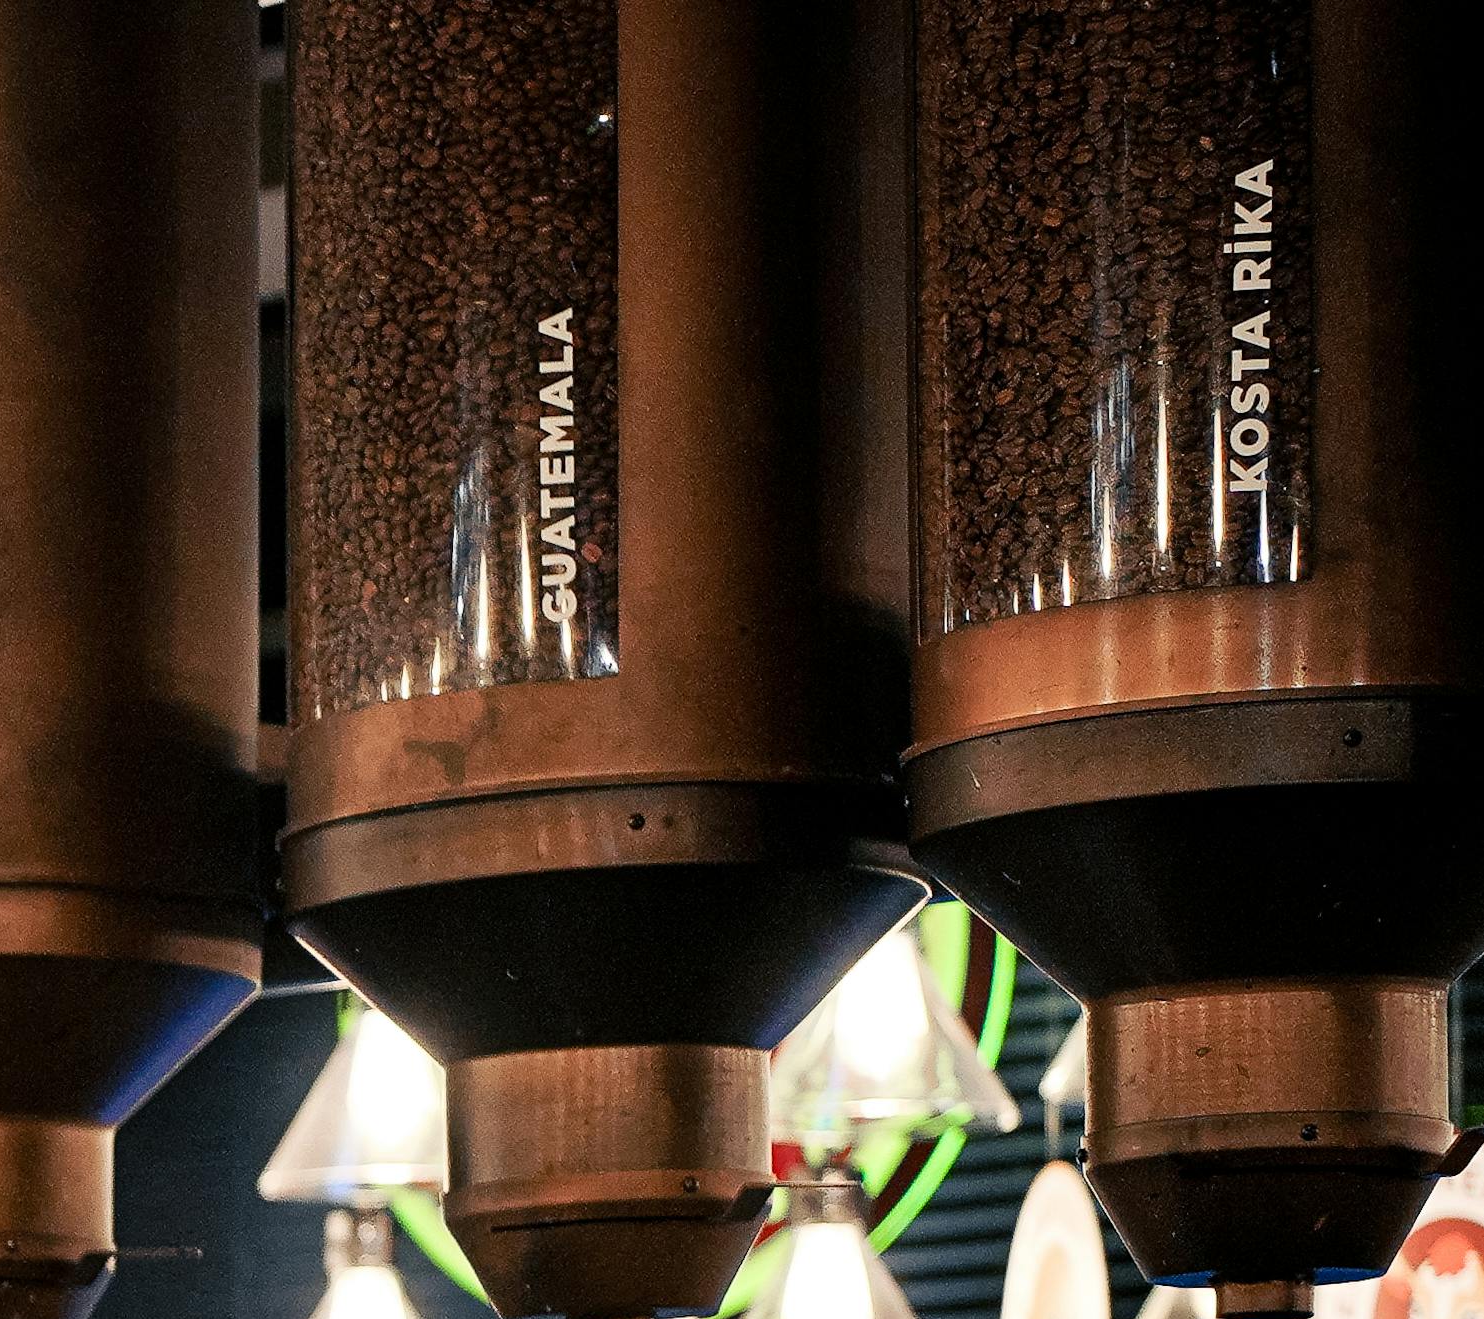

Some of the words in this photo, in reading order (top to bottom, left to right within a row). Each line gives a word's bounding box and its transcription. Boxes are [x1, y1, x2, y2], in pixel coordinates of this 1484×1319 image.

[1223, 159, 1274, 291] RİKA
[538, 307, 578, 624] GUATEMALA
[1229, 310, 1269, 492] KOSTA
